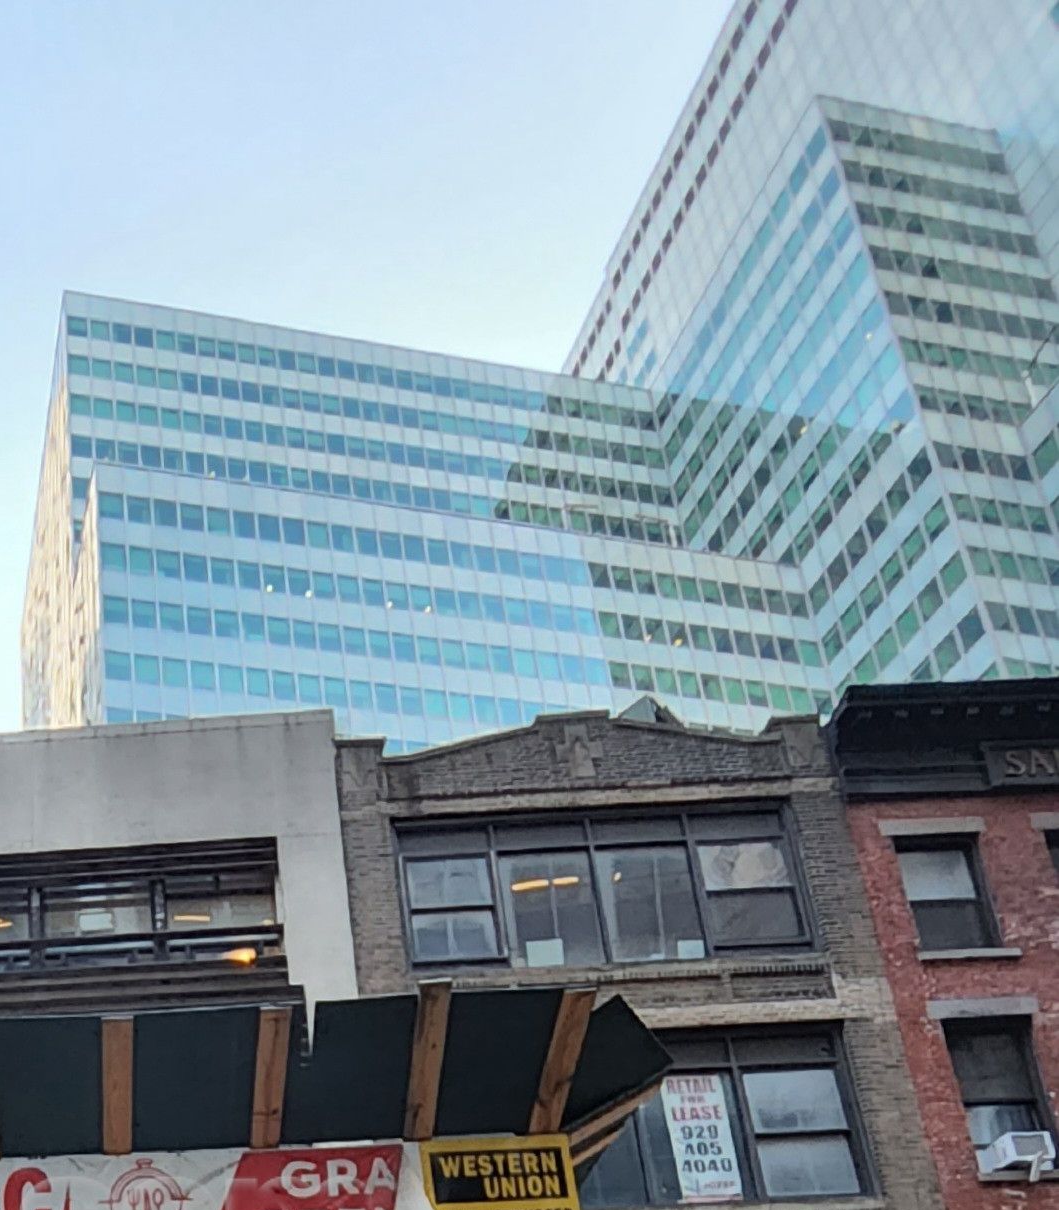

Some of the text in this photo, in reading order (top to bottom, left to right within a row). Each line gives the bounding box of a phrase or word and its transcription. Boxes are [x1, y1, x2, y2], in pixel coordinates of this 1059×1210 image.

[671, 1105, 722, 1121] LEASE
[439, 1151, 558, 1178] WESTERN
[483, 1175, 561, 1199] UNION
